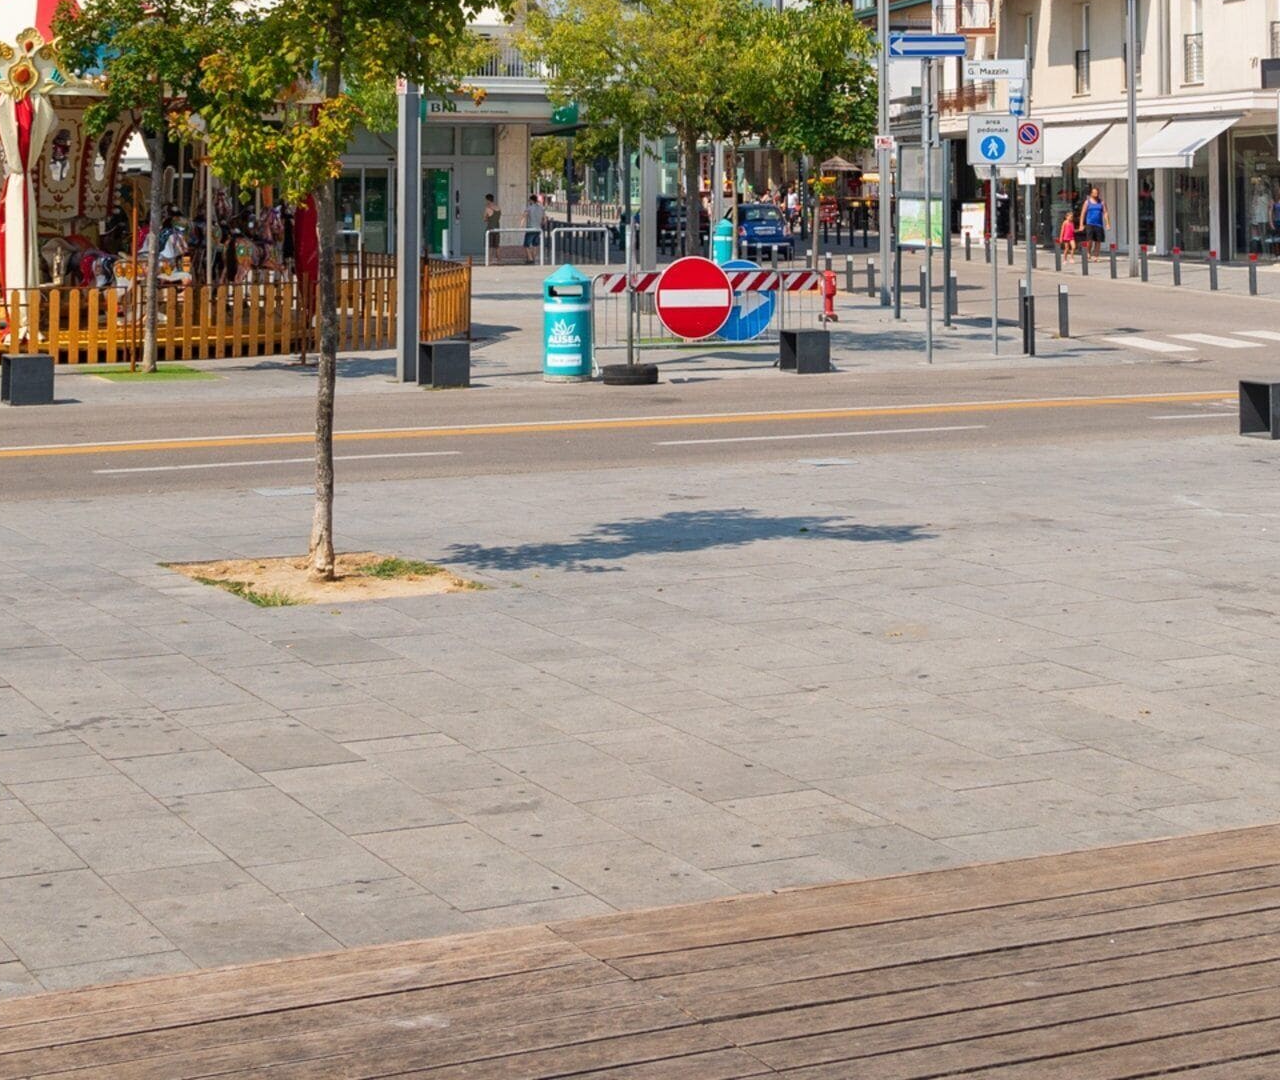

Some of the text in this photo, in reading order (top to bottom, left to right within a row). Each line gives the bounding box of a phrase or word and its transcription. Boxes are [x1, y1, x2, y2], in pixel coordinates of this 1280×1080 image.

[979, 67, 1009, 76] Mazzini
[977, 126, 1009, 134] pedonale
[548, 334, 581, 344] ALISEA
